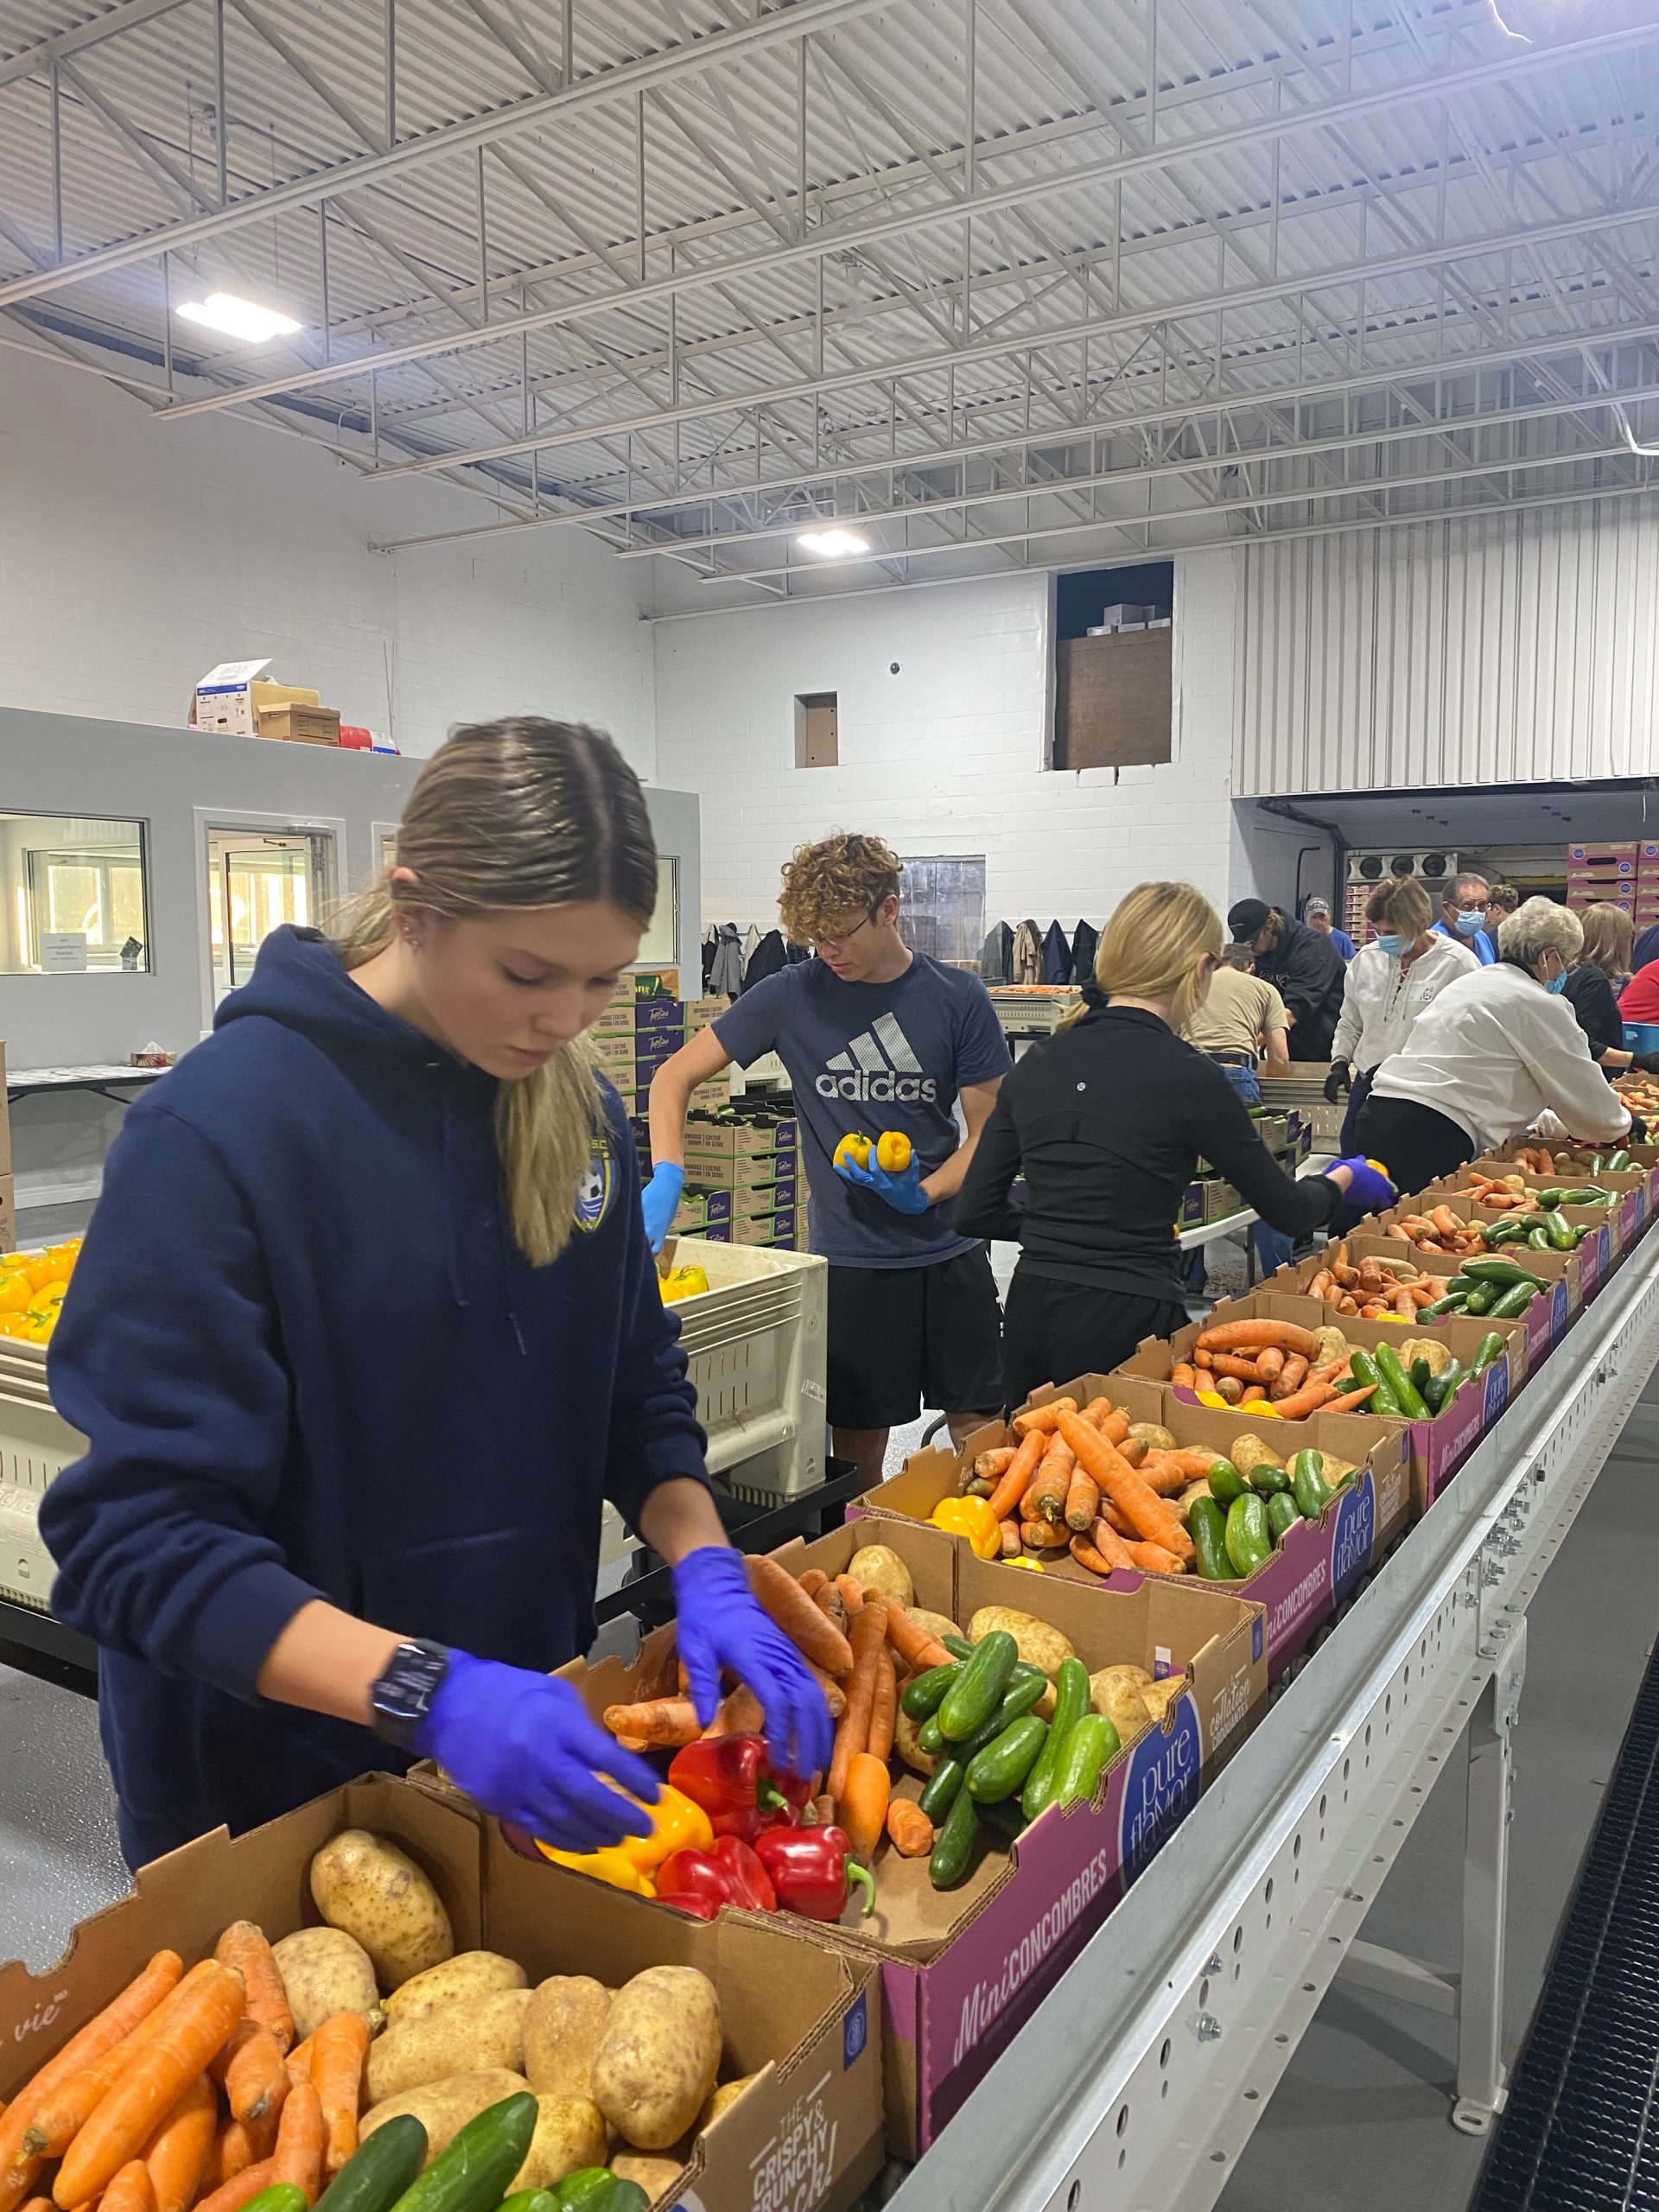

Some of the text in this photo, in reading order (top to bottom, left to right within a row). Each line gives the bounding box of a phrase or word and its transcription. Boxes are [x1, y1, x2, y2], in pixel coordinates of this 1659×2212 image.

[648, 1007, 670, 1022] Topline
[648, 1035, 670, 1051] Topline
[815, 1069, 937, 1103] adidas
[591, 1139, 608, 1150] SC
[1344, 1496, 1370, 1541] pure
[1336, 1522, 1370, 1581] flavor
[1267, 1558, 1326, 1640] niCONCOMBRES
[1141, 1728, 1191, 1818] pure
[1130, 1764, 1192, 1869] flavor
[779, 2095, 804, 2139] THE
[751, 2120, 828, 2212] RUNCHY
